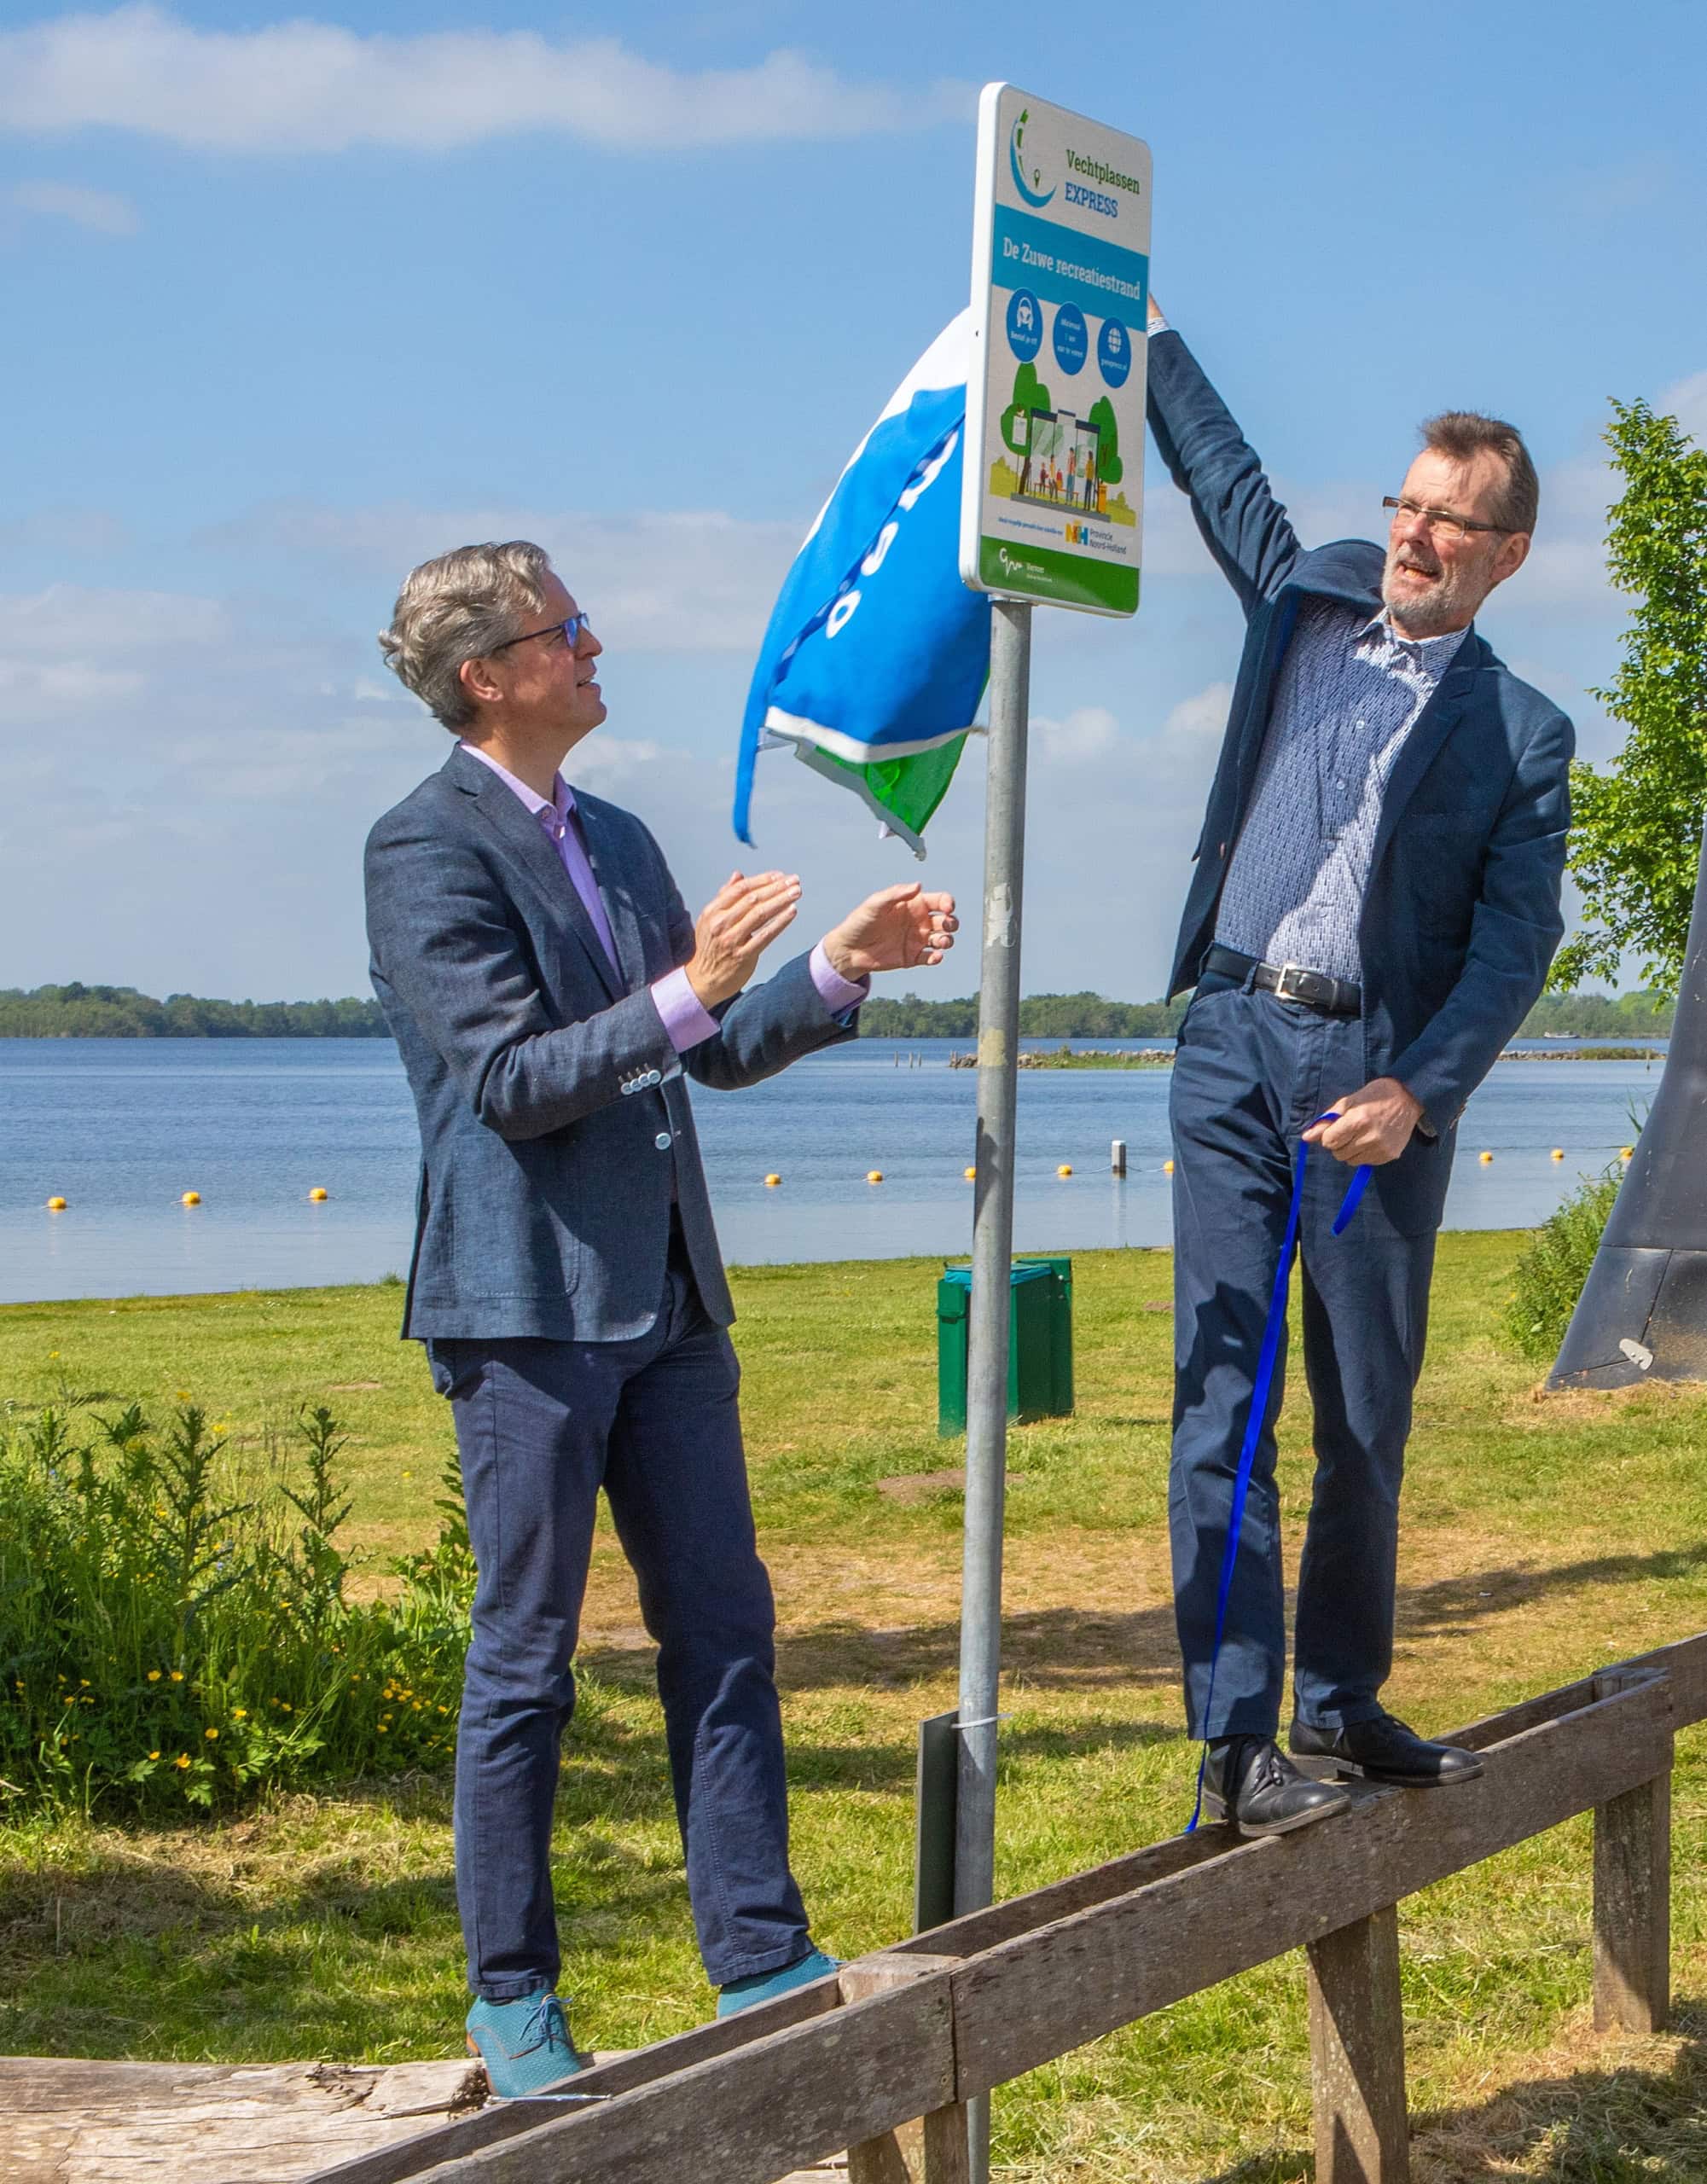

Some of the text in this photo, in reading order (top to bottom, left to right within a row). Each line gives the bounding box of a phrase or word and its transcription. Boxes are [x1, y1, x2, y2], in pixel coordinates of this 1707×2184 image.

[1066, 149, 1141, 195] Vechtplassen
[1065, 182, 1118, 218] EXPRESS
[1003, 236, 1141, 300] De Zuwe recreatiestrand
